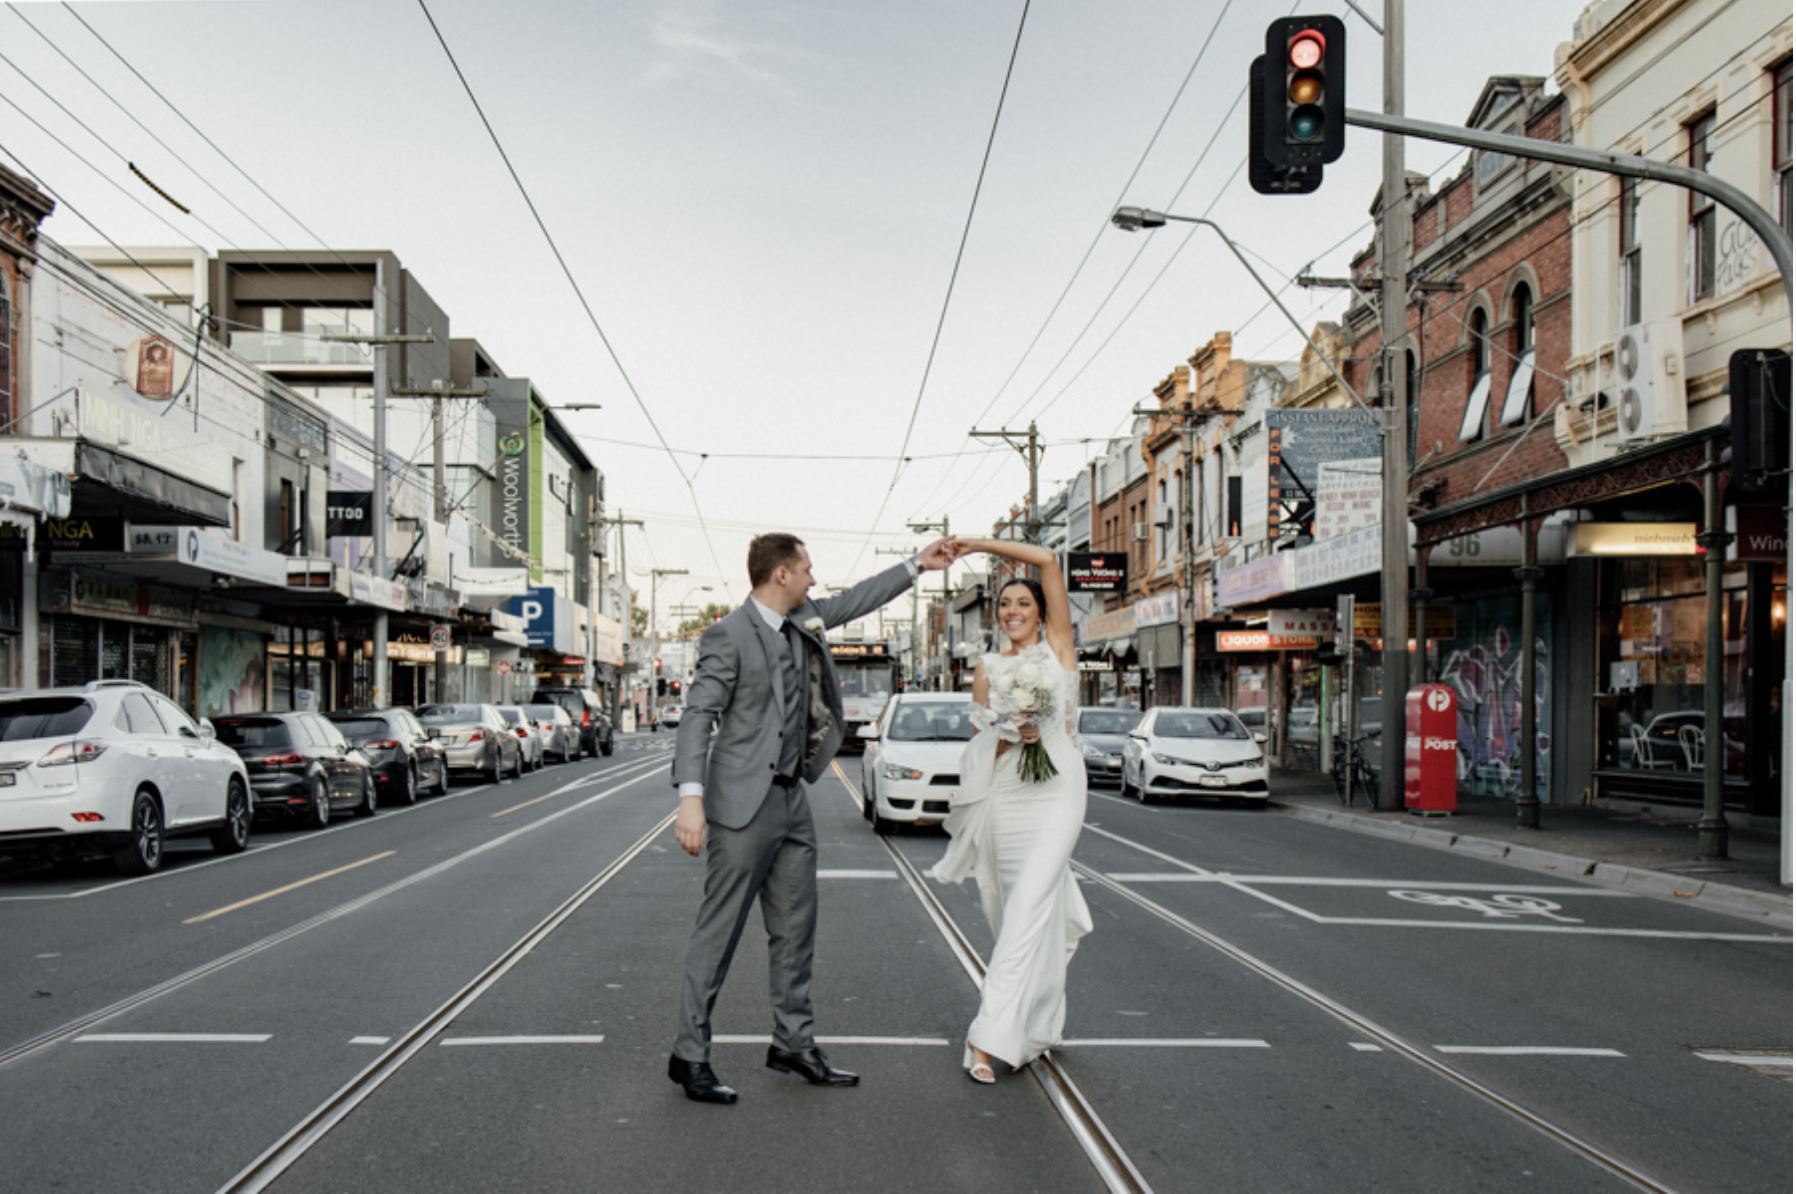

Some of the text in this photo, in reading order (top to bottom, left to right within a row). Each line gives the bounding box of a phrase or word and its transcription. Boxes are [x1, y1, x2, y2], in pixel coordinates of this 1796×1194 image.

[1276, 413, 1323, 423] INSTANT
[1269, 429, 1281, 538] FOR LEASE
[48, 520, 94, 539] NGA
[1449, 534, 1480, 558] 96
[522, 601, 543, 629] P
[432, 632, 447, 643] 40
[1221, 634, 1315, 646] LIQUOR STORE
[1424, 737, 1457, 750] POST
